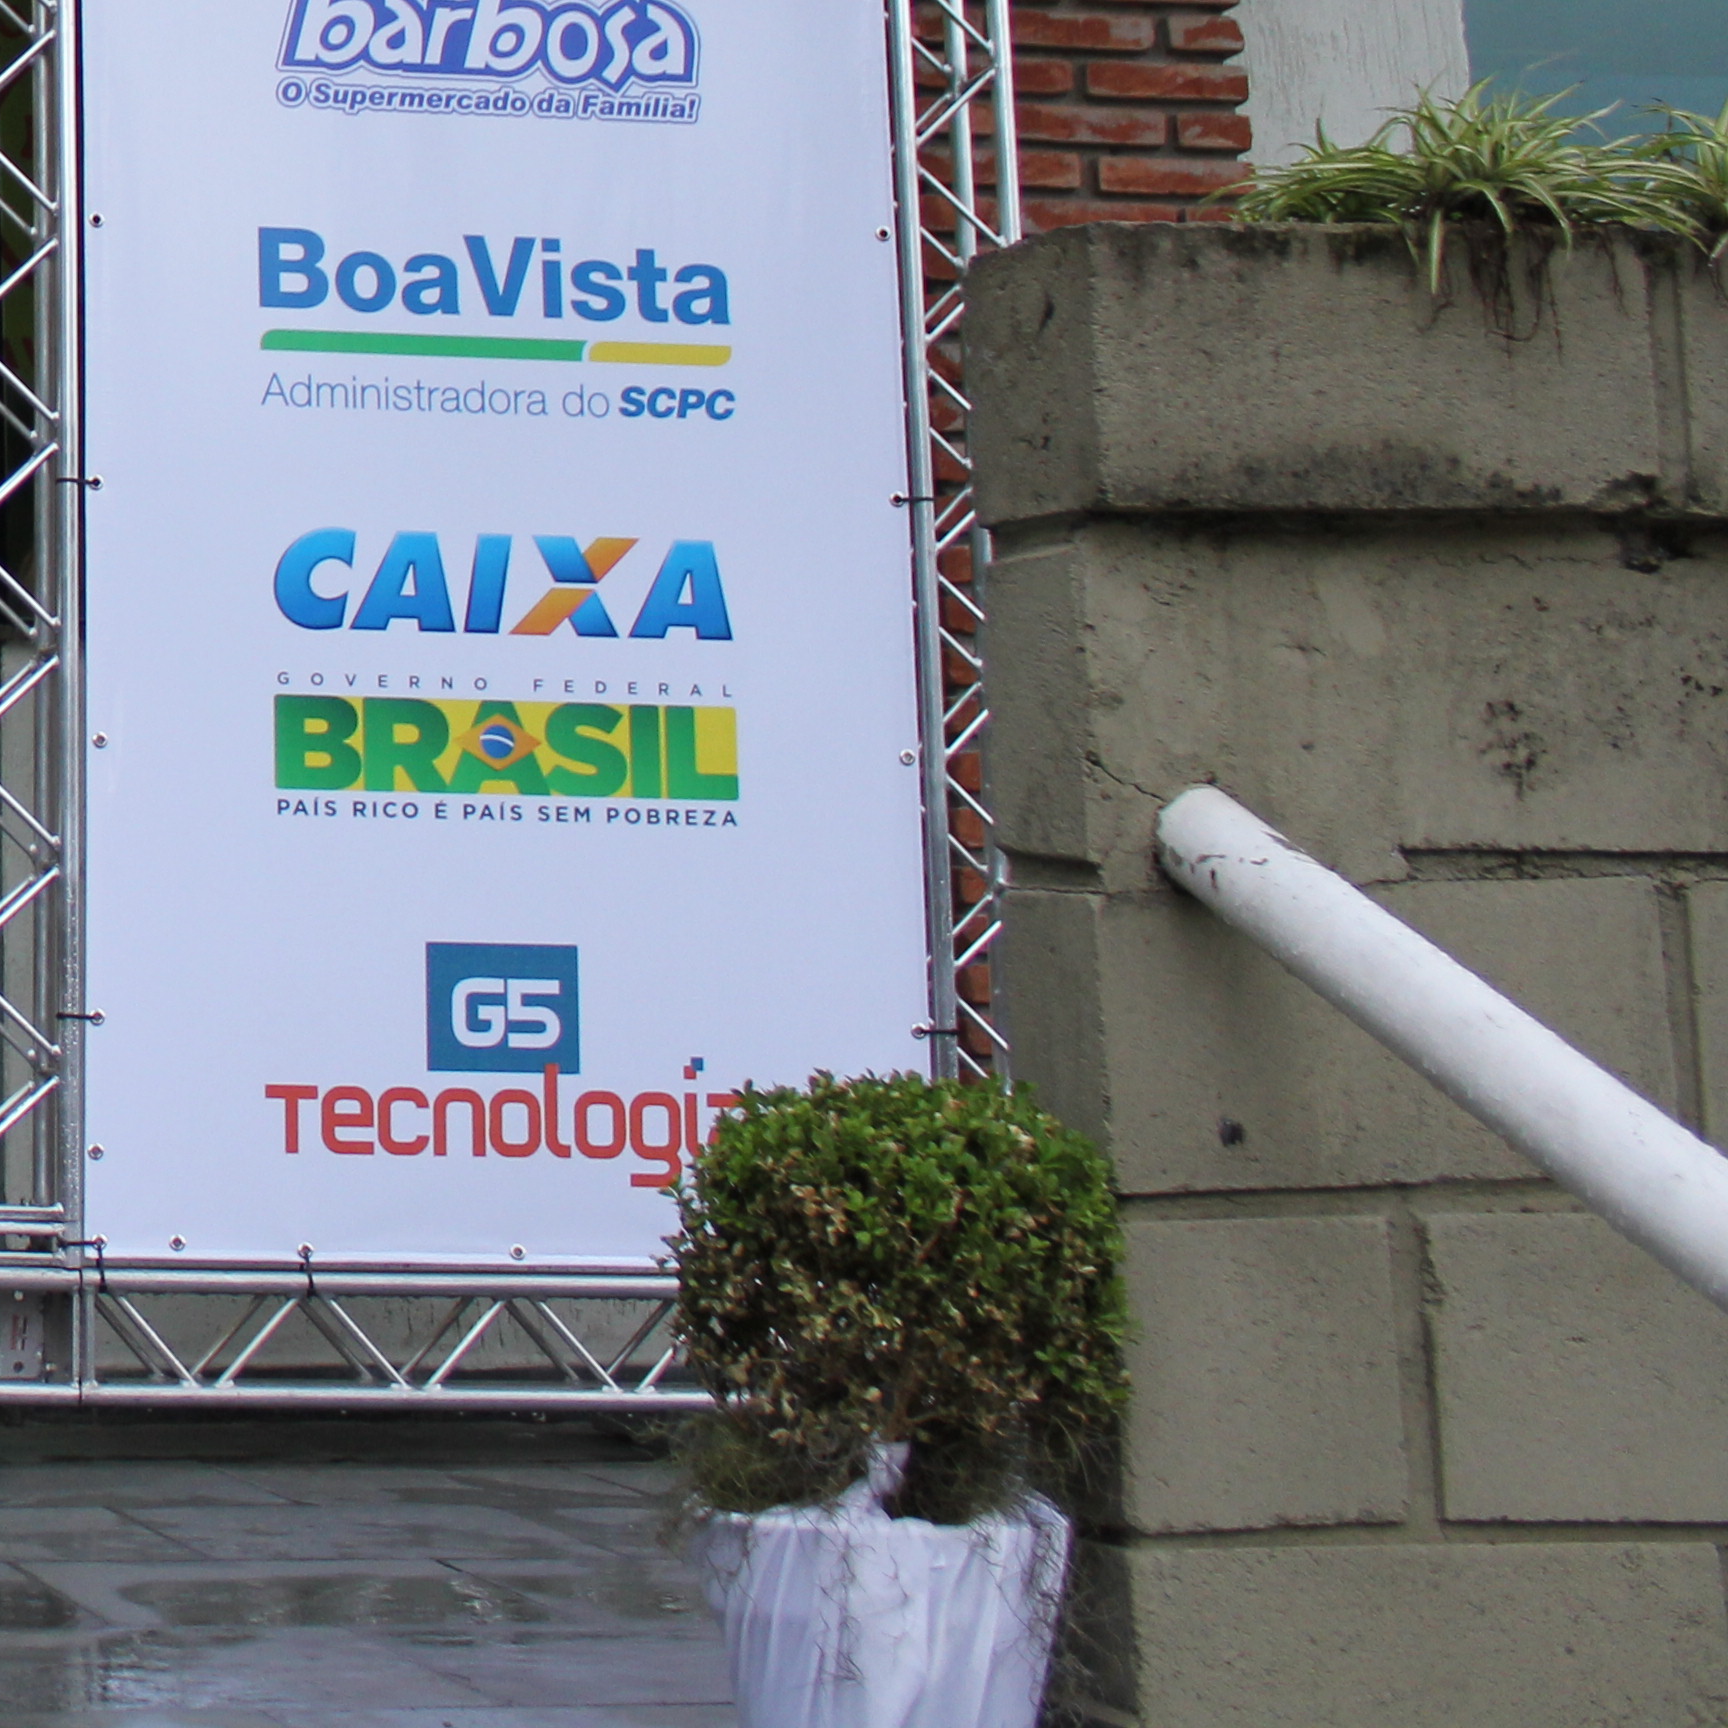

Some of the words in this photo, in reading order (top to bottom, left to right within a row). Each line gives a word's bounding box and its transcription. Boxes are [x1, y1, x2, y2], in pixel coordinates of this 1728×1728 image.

[280, 81, 304, 103] O
[312, 82, 527, 113] Supermercado
[536, 92, 571, 114] da
[581, 92, 697, 120] Família!
[257, 226, 731, 325] BoaVista
[261, 371, 549, 417] Administradora
[562, 382, 611, 419] do
[617, 386, 737, 421] SCPC
[273, 526, 733, 642] CAIXA
[277, 672, 488, 692] GOVERNO
[533, 679, 733, 698] FEDERAL
[274, 694, 739, 801] BRASIL
[276, 796, 338, 819] PAÍS
[352, 800, 420, 820] RICO
[434, 798, 448, 820] É
[462, 799, 524, 822] PAÍS
[537, 803, 592, 824] SEM
[606, 806, 738, 828] POBREZA
[450, 977, 561, 1049] G5
